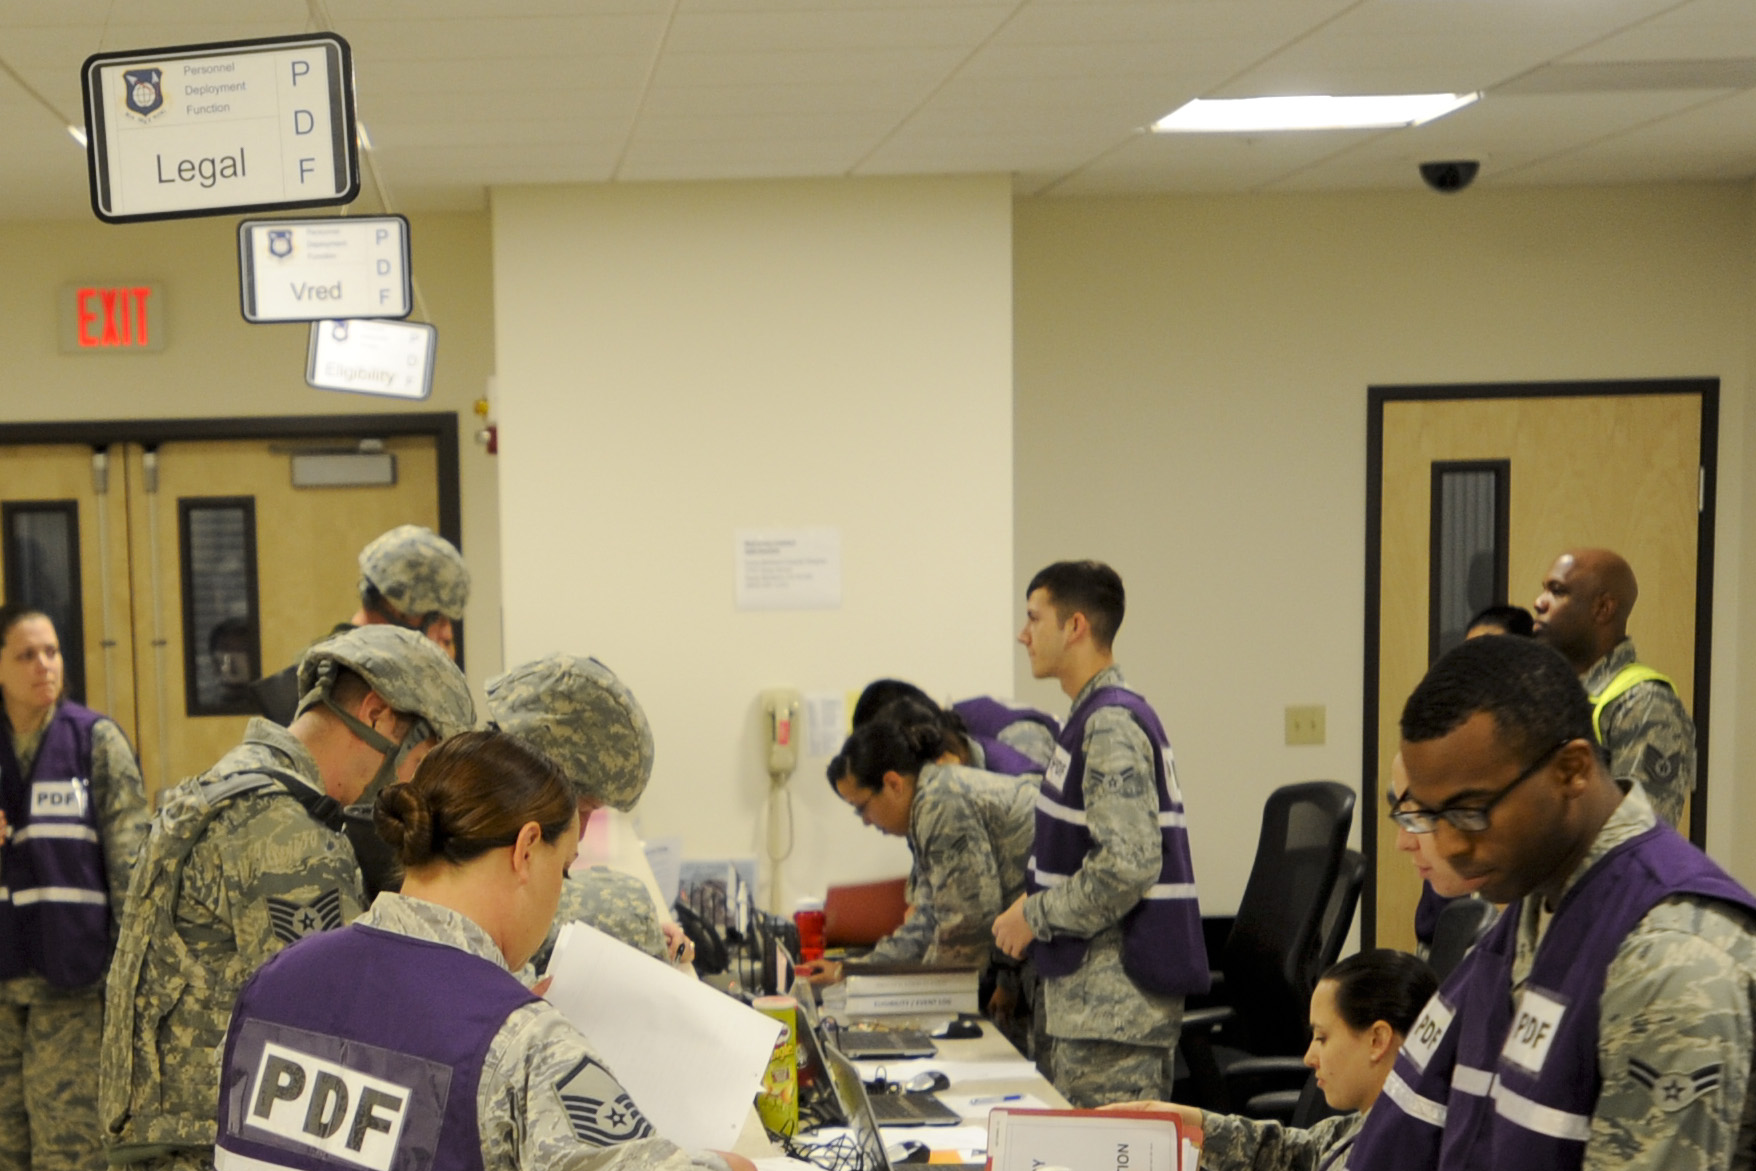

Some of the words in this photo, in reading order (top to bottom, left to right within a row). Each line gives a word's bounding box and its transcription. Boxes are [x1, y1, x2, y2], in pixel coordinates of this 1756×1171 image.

[183, 62, 236, 77] Personnel
[291, 60, 310, 87] P
[184, 81, 246, 96] Deployment
[186, 103, 231, 115] Function
[294, 109, 315, 136] D
[156, 147, 247, 188] Legal
[299, 157, 316, 184] F
[290, 280, 343, 302] Vred
[76, 287, 151, 348] EXIT
[324, 361, 397, 387] Eligibility
[36, 791, 76, 807] PDF
[1414, 1014, 1442, 1050] PDF
[1514, 1012, 1552, 1050] PDF
[252, 1053, 404, 1154] PDF
